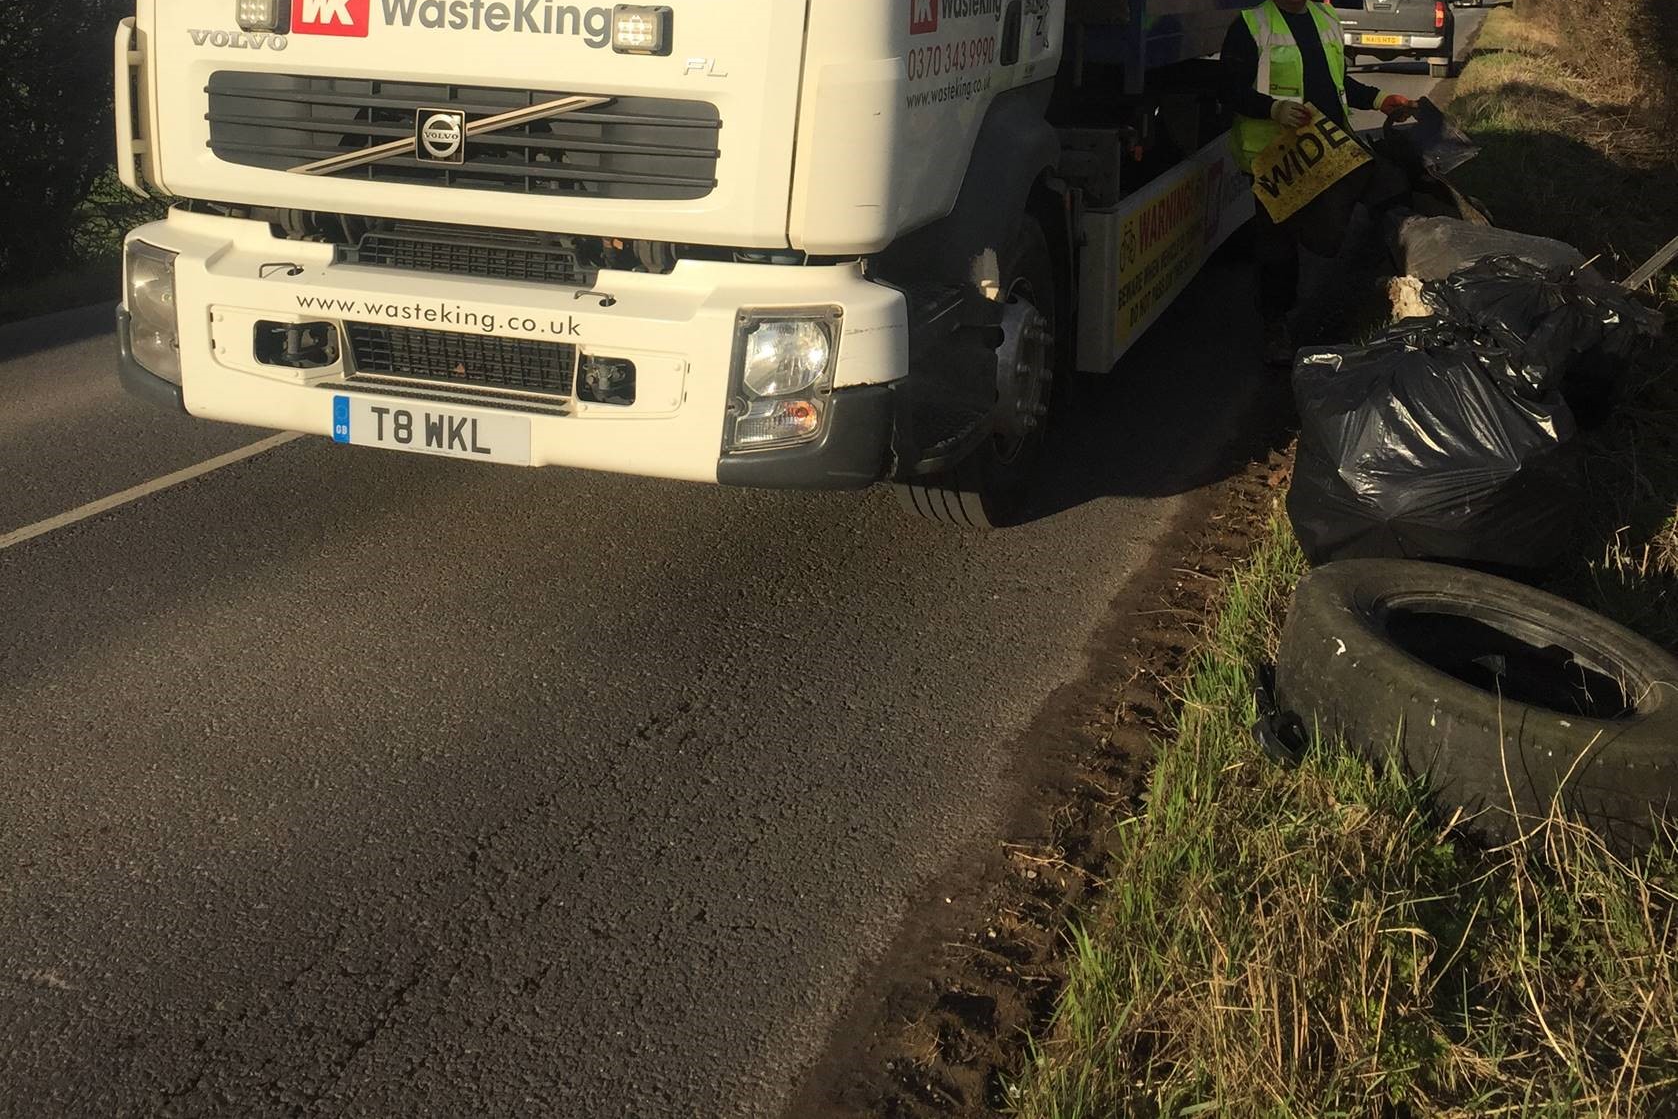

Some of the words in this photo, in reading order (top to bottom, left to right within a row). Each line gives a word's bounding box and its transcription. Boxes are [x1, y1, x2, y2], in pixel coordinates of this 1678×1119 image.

[187, 29, 288, 51] VOLVO
[907, 45, 942, 81] 0370
[944, 40, 967, 74] 343
[969, 36, 995, 68] 9990
[683, 57, 729, 78] FL
[906, 73, 992, 110] www.wasteking.co.uk
[424, 131, 459, 140] VOLVO
[1258, 117, 1351, 199] WIDE
[296, 294, 581, 336] www.wasteking.co.uk
[336, 424, 348, 435] GB
[371, 406, 413, 444] T8
[425, 412, 491, 455] WKL
